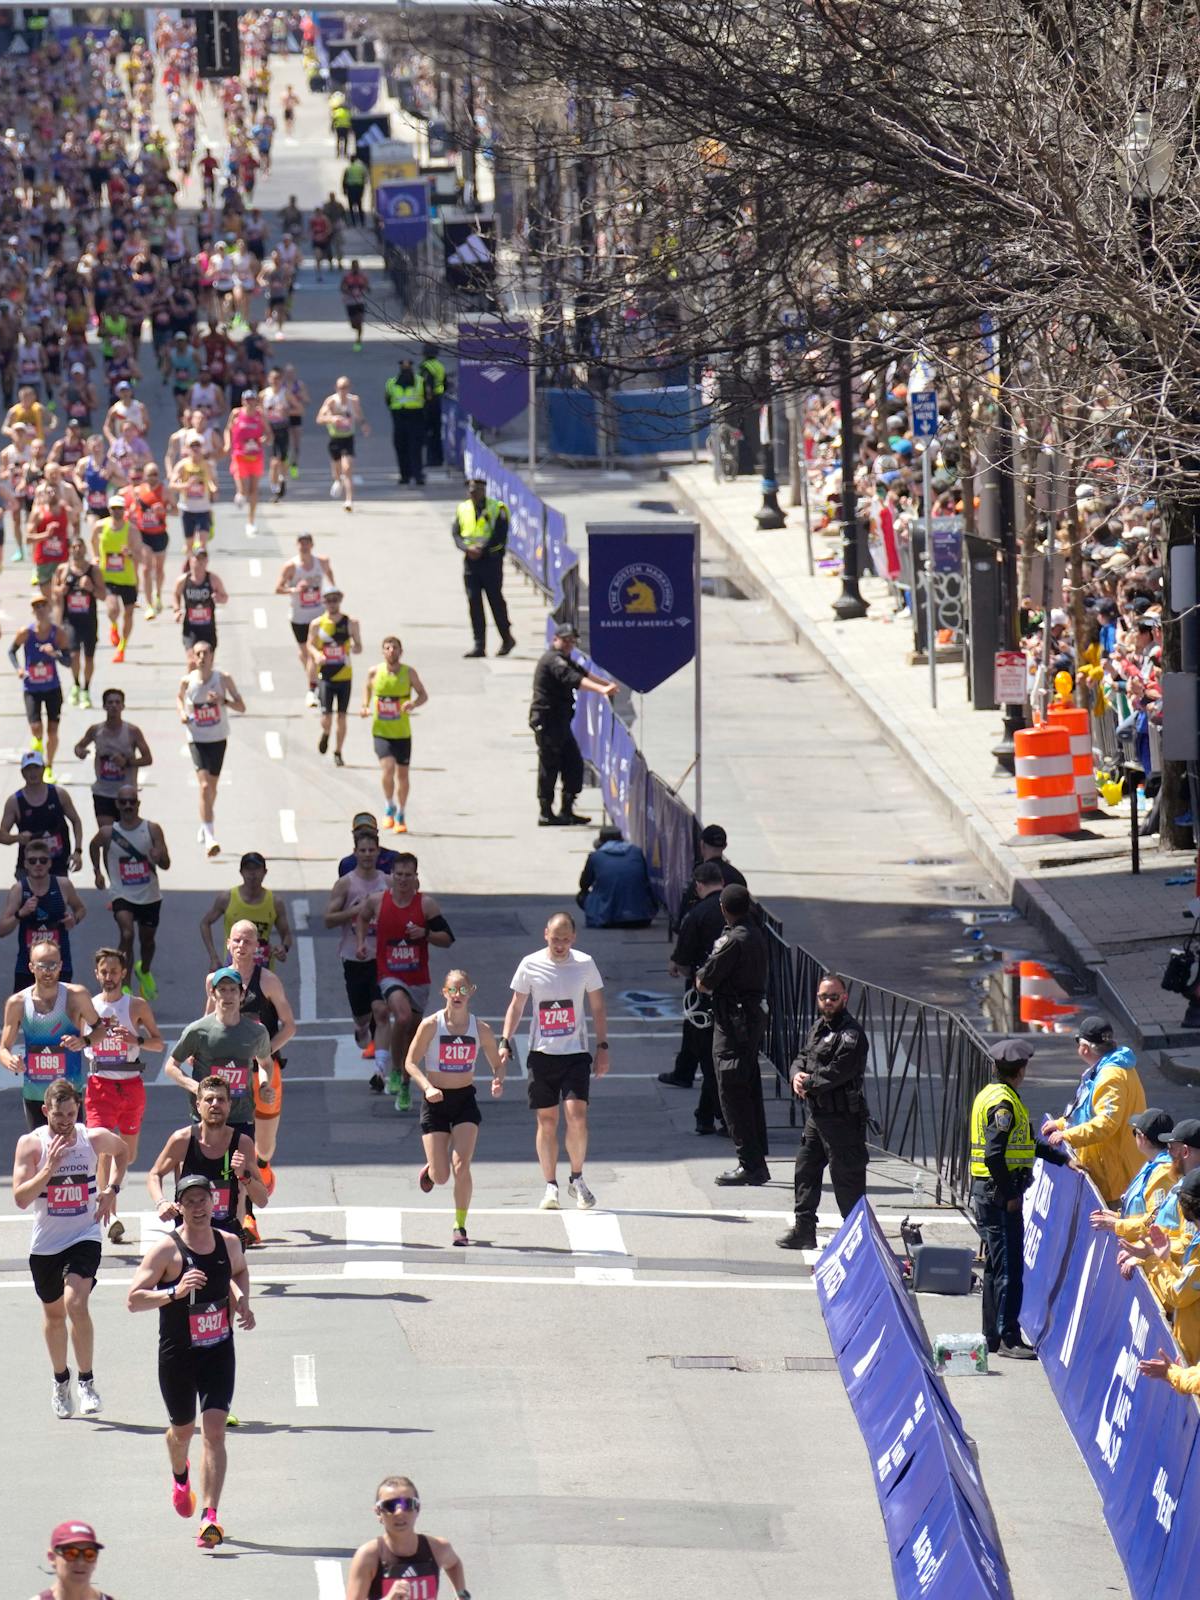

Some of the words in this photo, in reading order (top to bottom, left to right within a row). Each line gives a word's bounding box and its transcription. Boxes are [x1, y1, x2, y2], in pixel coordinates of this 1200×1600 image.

[614, 565, 643, 589] BOSTON
[645, 566, 672, 607] MARATHON
[636, 618, 674, 627] AMERICA
[545, 1011, 568, 1025] 2742
[446, 1046, 469, 1060] 2167
[35, 1056, 59, 1069] 1699
[55, 1187, 82, 1203] 2700
[198, 1314, 222, 1333] 3427
